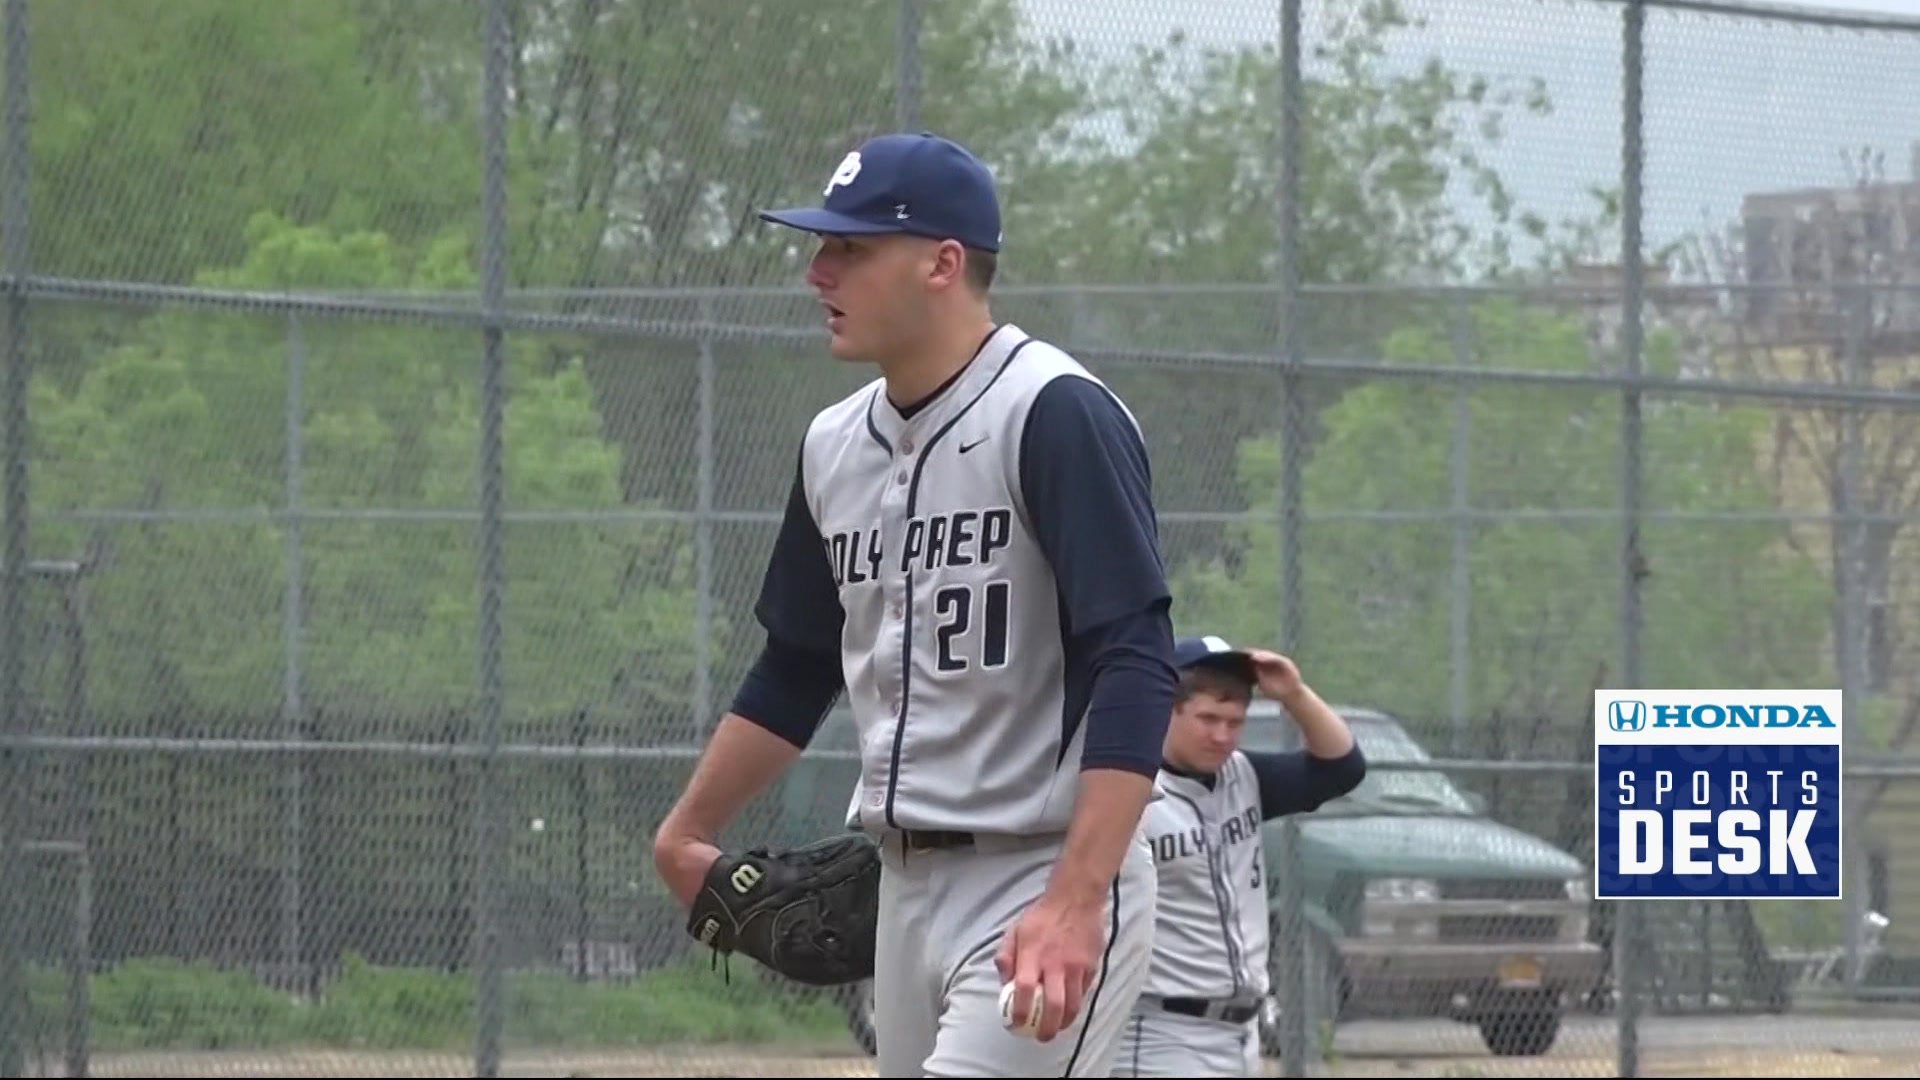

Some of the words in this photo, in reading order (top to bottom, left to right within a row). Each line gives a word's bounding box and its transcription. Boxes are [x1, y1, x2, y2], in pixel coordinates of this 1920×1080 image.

[823, 528, 883, 586] OLY
[901, 508, 1012, 573] PREP
[934, 580, 1011, 674] 21
